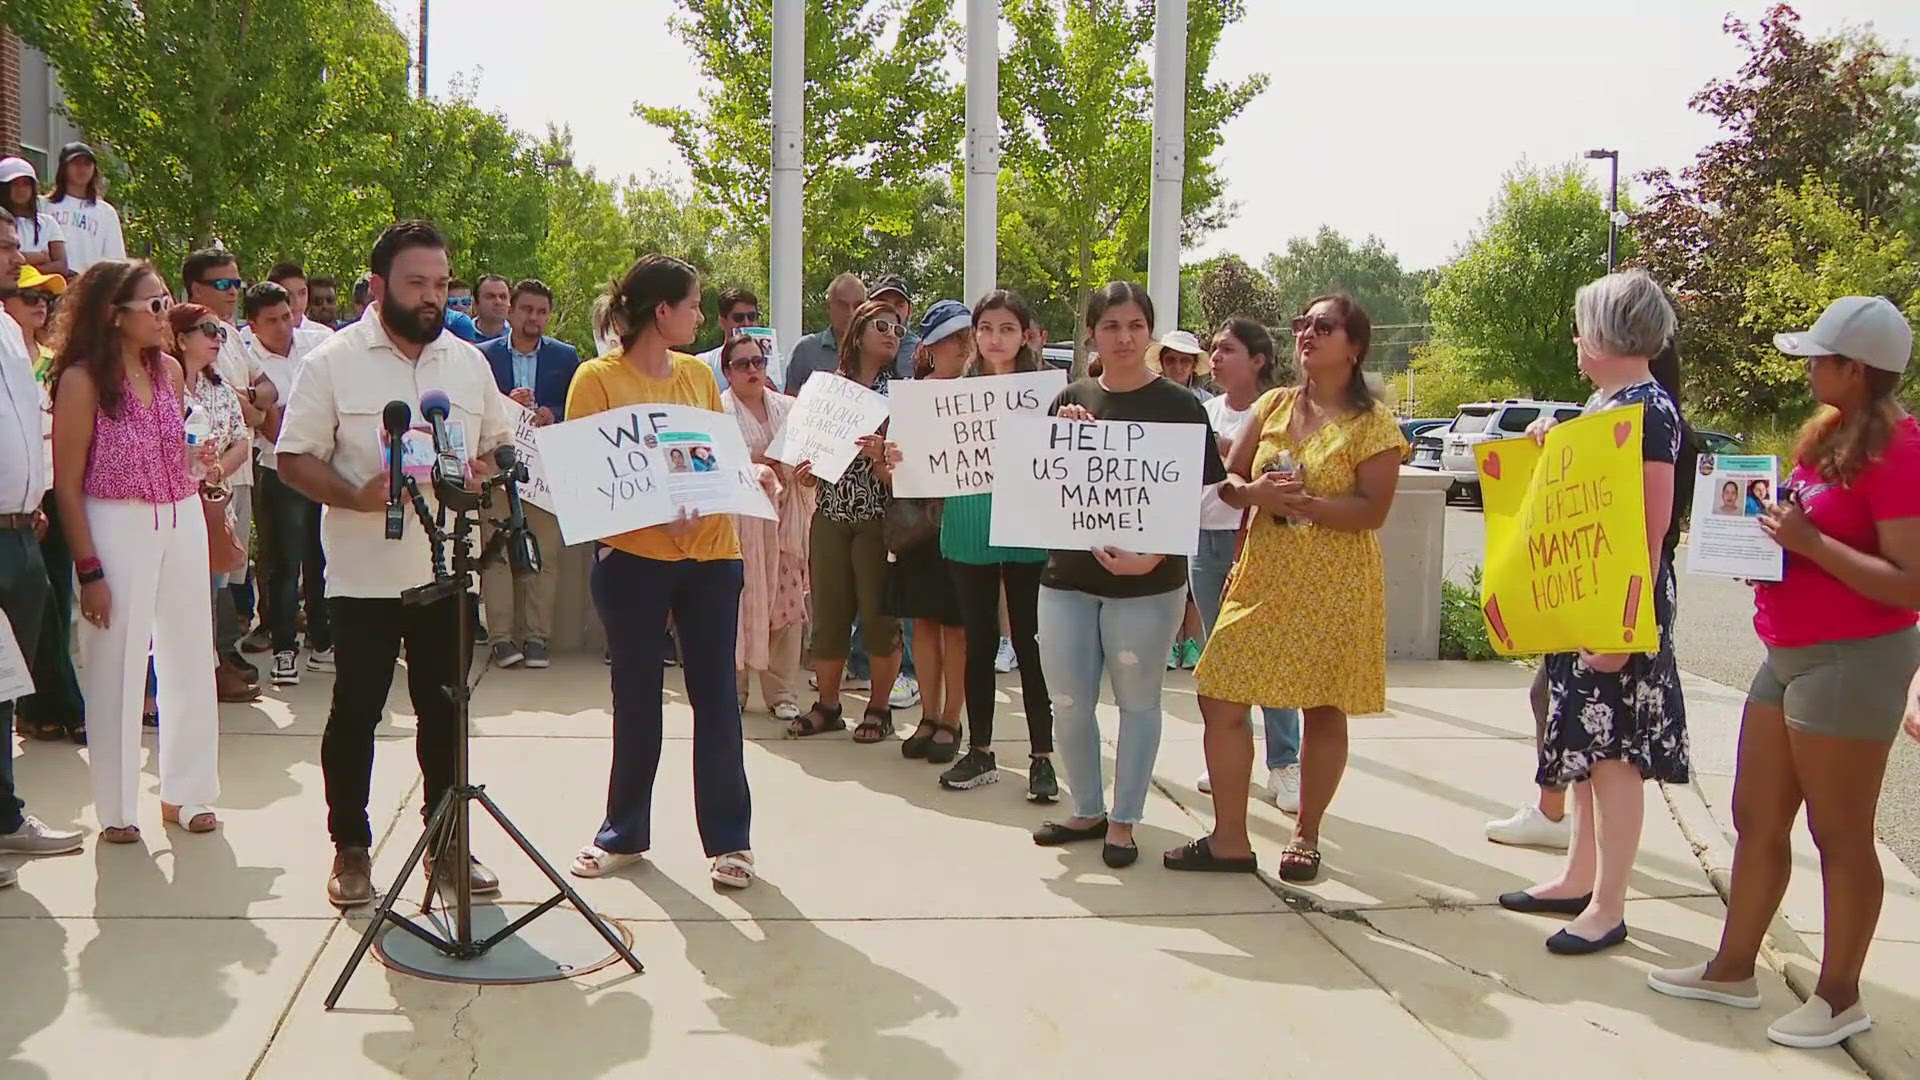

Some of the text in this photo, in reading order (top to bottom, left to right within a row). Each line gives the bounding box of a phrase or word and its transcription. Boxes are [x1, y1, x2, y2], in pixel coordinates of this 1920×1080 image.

[935, 389, 1040, 418] HELP US
[598, 412, 668, 449] WE
[1050, 422, 1145, 452] HELP
[928, 446, 995, 475] MAM
[1033, 455, 1180, 484] US BRING
[597, 477, 656, 511] YOU
[1062, 484, 1151, 508] MAMTA
[1072, 508, 1144, 532] HOME!
[1528, 522, 1612, 571] MAMTA
